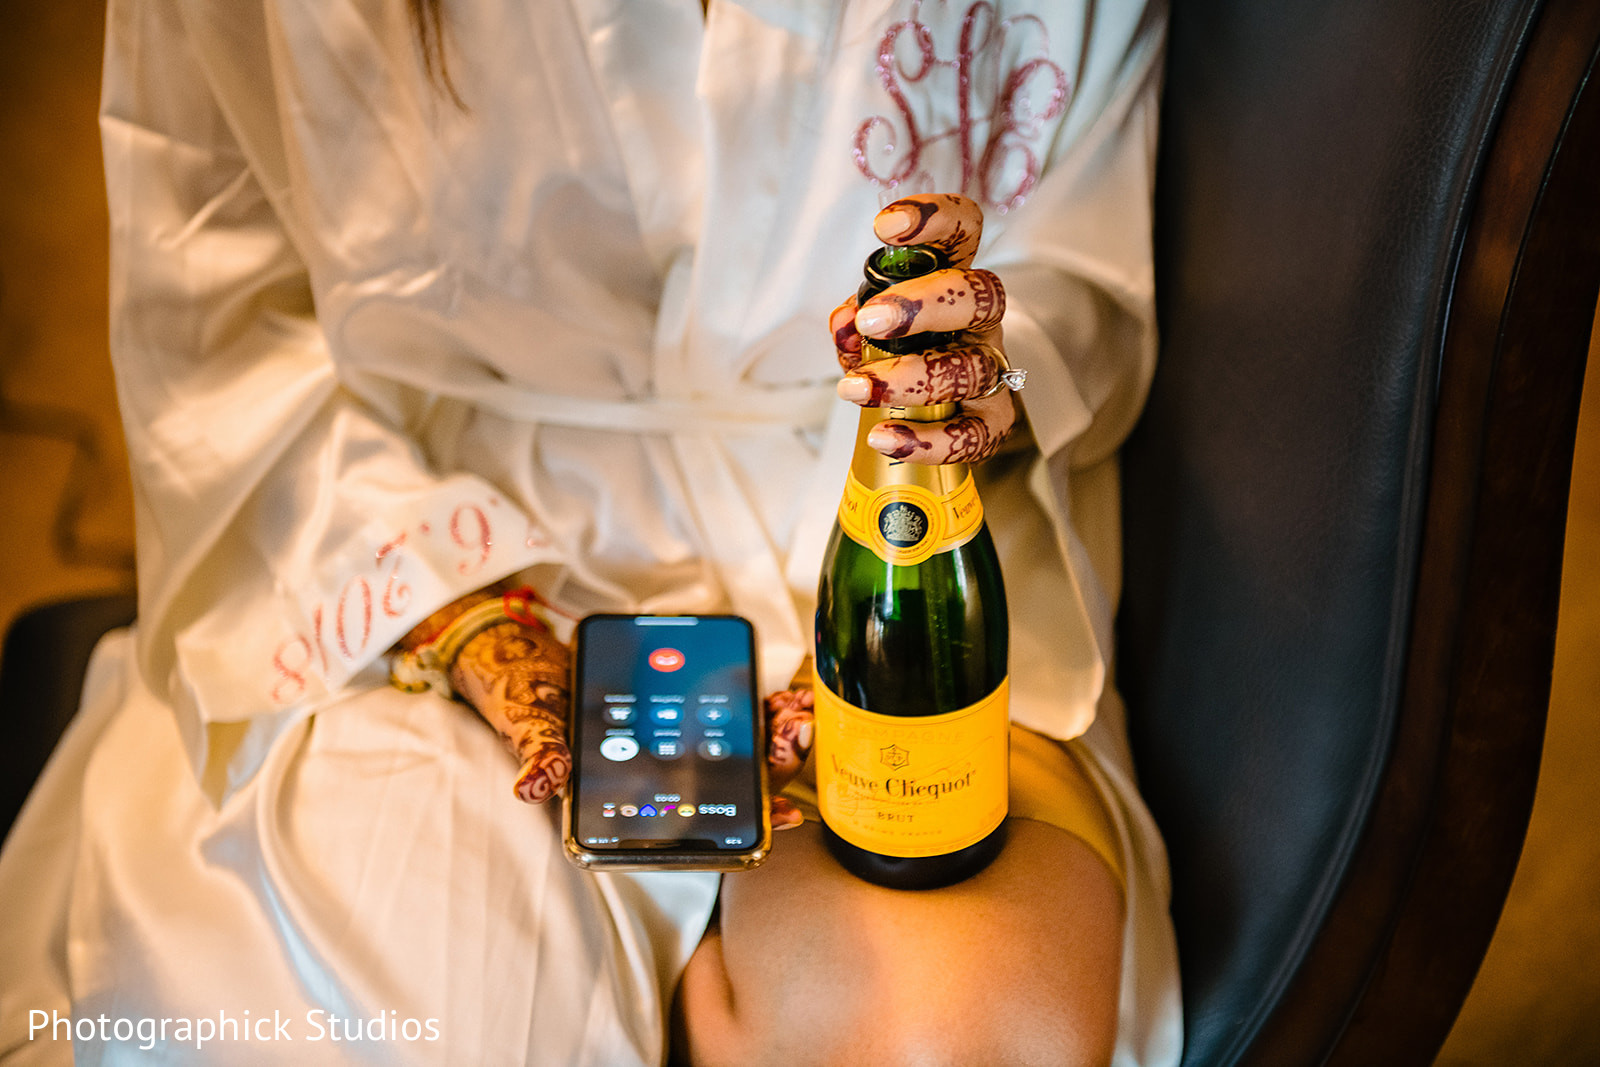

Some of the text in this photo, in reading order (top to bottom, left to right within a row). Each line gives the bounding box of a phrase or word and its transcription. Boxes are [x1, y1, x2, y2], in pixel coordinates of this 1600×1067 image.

[831, 752, 879, 791] Veuve
[885, 770, 973, 799] Clicquot
[698, 803, 737, 818] Boss
[877, 810, 915, 824] BRUT
